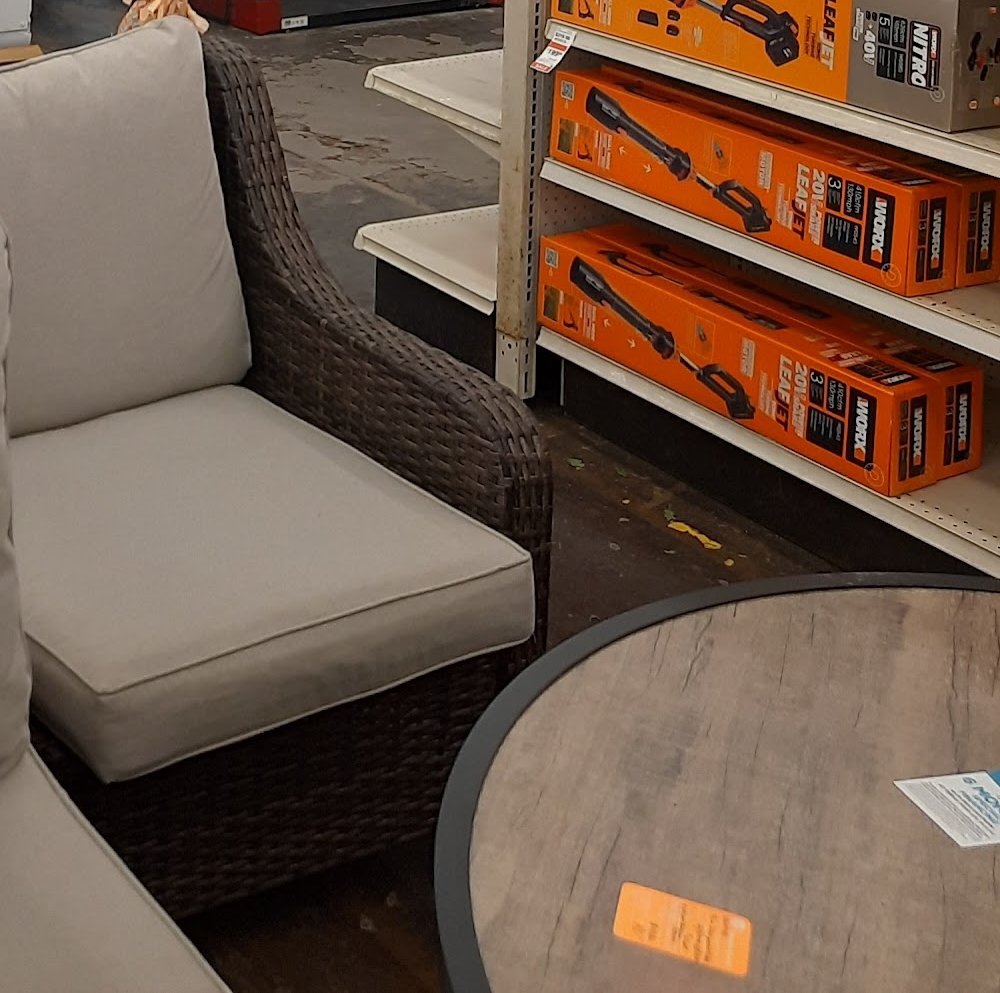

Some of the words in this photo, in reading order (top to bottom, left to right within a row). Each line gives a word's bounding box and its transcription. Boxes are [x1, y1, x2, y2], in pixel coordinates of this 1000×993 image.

[879, 16, 891, 27] 5
[863, 29, 876, 66] 40V
[910, 22, 929, 88] NITRO
[791, 163, 811, 241] LEAFJET
[811, 167, 826, 202] 20V
[828, 176, 842, 189] 3
[870, 196, 888, 264] WORX
[775, 354, 793, 432] LEAFJET
[810, 370, 824, 385] 3
[854, 395, 869, 462] WORX
